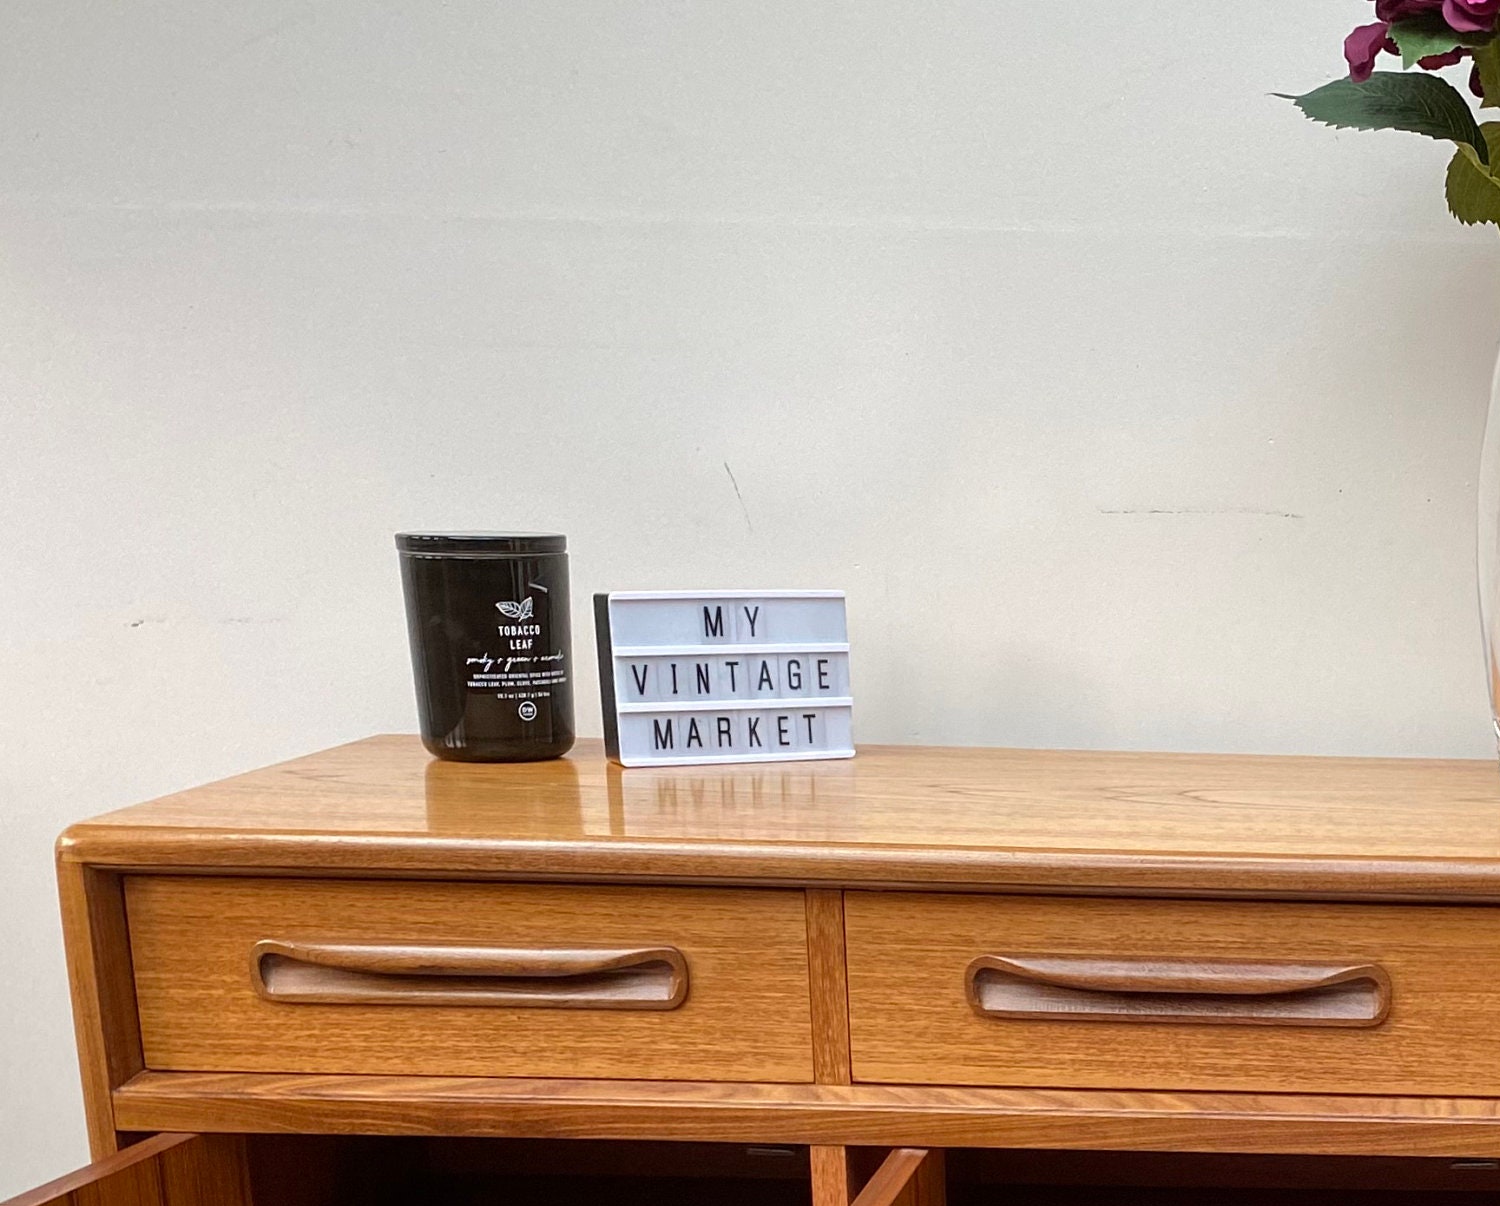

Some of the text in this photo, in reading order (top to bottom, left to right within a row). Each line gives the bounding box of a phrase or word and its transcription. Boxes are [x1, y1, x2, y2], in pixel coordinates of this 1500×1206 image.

[498, 625, 540, 637] TOBACCO
[703, 605, 759, 638] MY
[509, 639, 533, 650] LEAF
[631, 659, 830, 696] VINTAGE
[653, 714, 816, 750] MARKET
